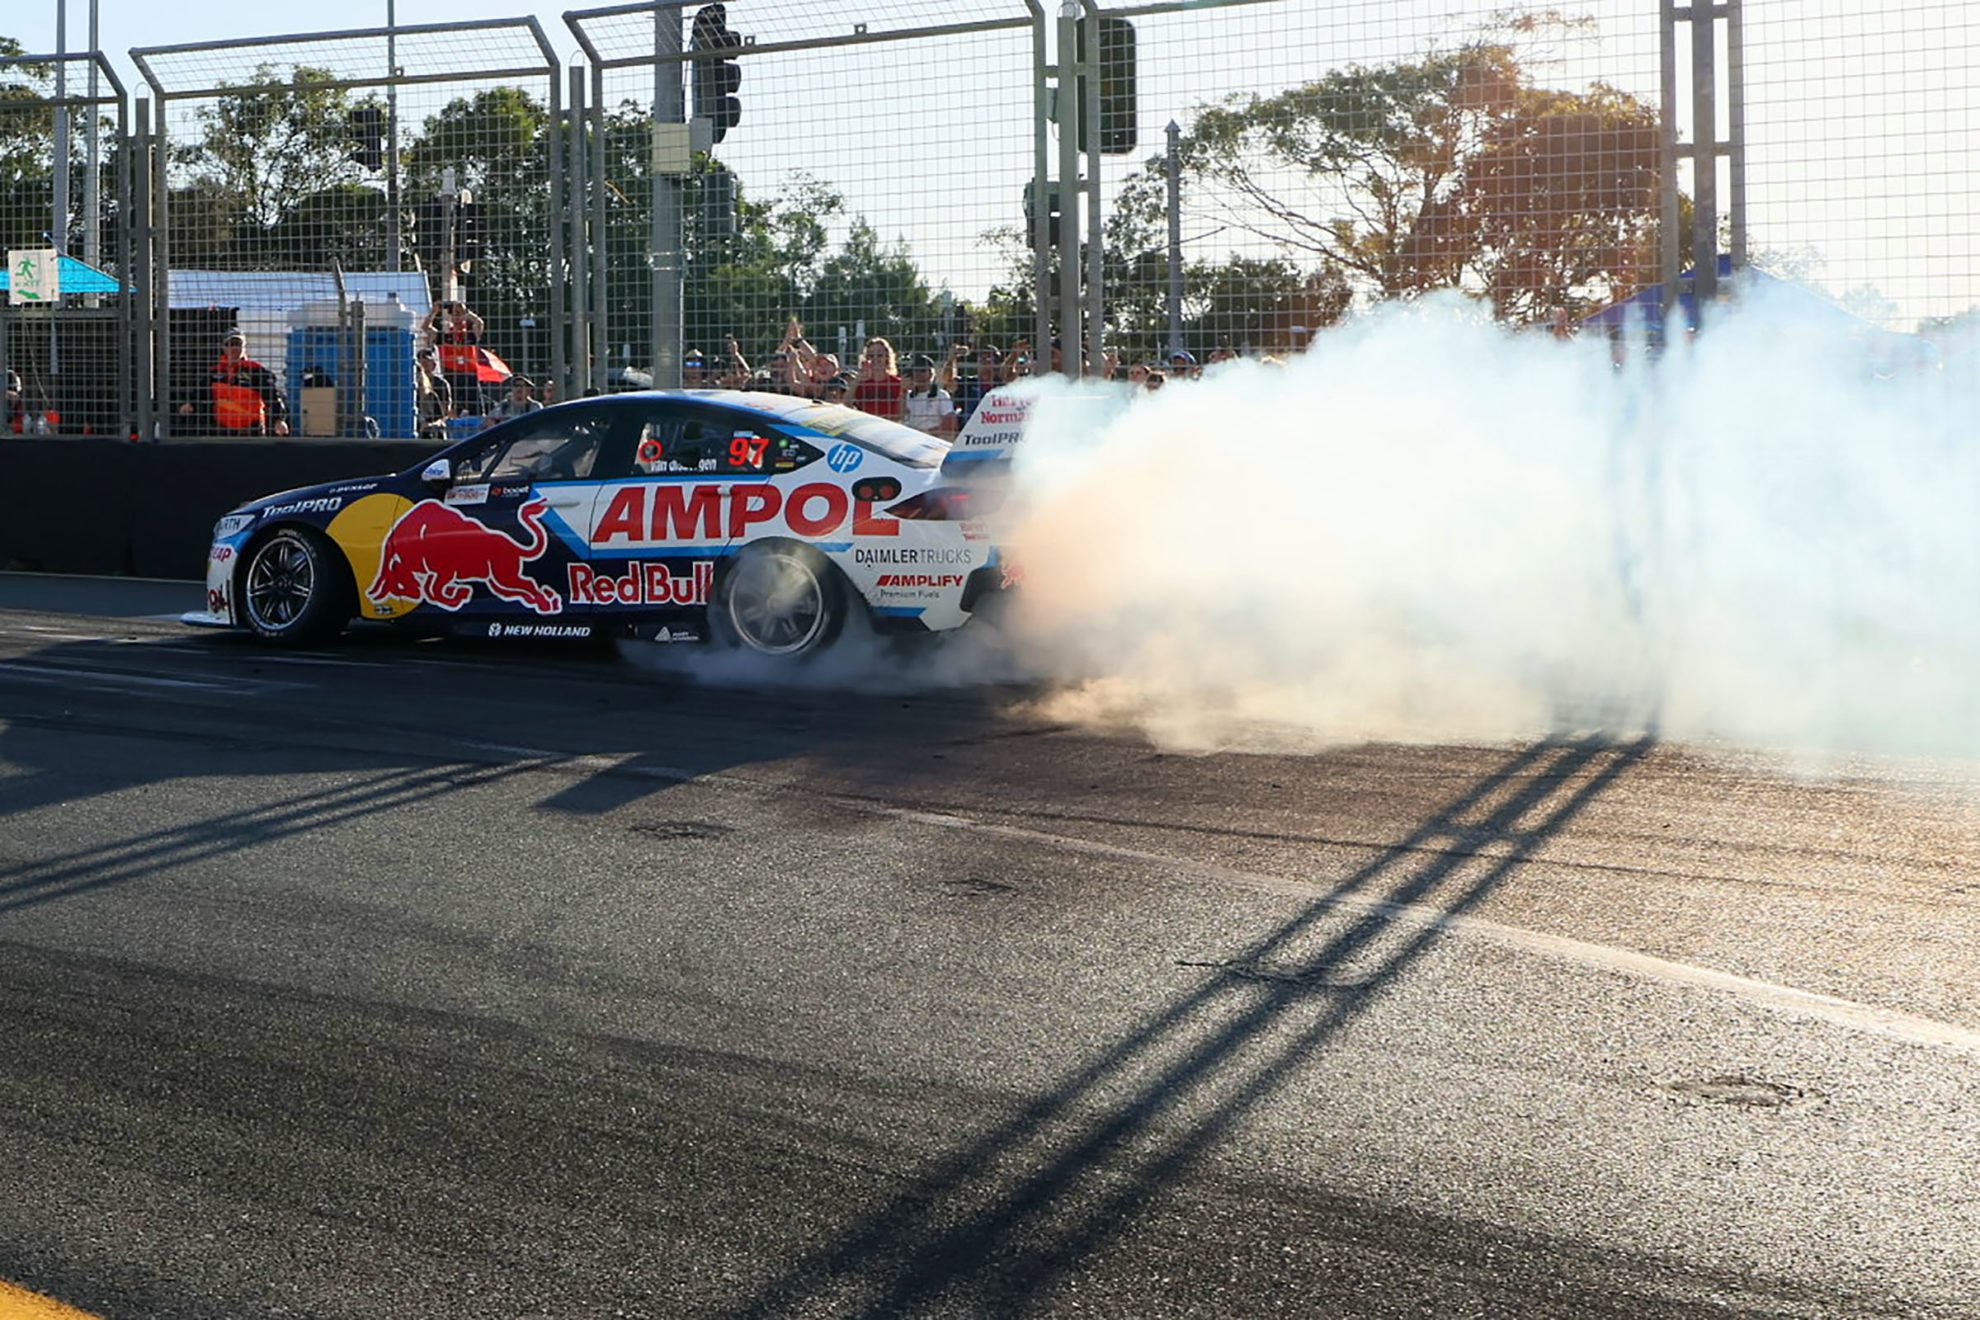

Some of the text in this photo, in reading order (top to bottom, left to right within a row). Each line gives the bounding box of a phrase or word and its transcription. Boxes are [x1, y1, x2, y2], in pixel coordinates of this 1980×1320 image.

[980, 410, 1031, 425] Norma
[964, 431, 1024, 446] ToolPR
[728, 437, 769, 467] 97
[831, 443, 862, 474] hp
[262, 496, 342, 519] ToolPRO
[591, 483, 900, 542] AMPOL
[567, 561, 641, 606] Red
[889, 575, 964, 587] AMPLIFY
[880, 589, 940, 600] Premium Fuels
[503, 625, 591, 637] NEW HOLLAND
